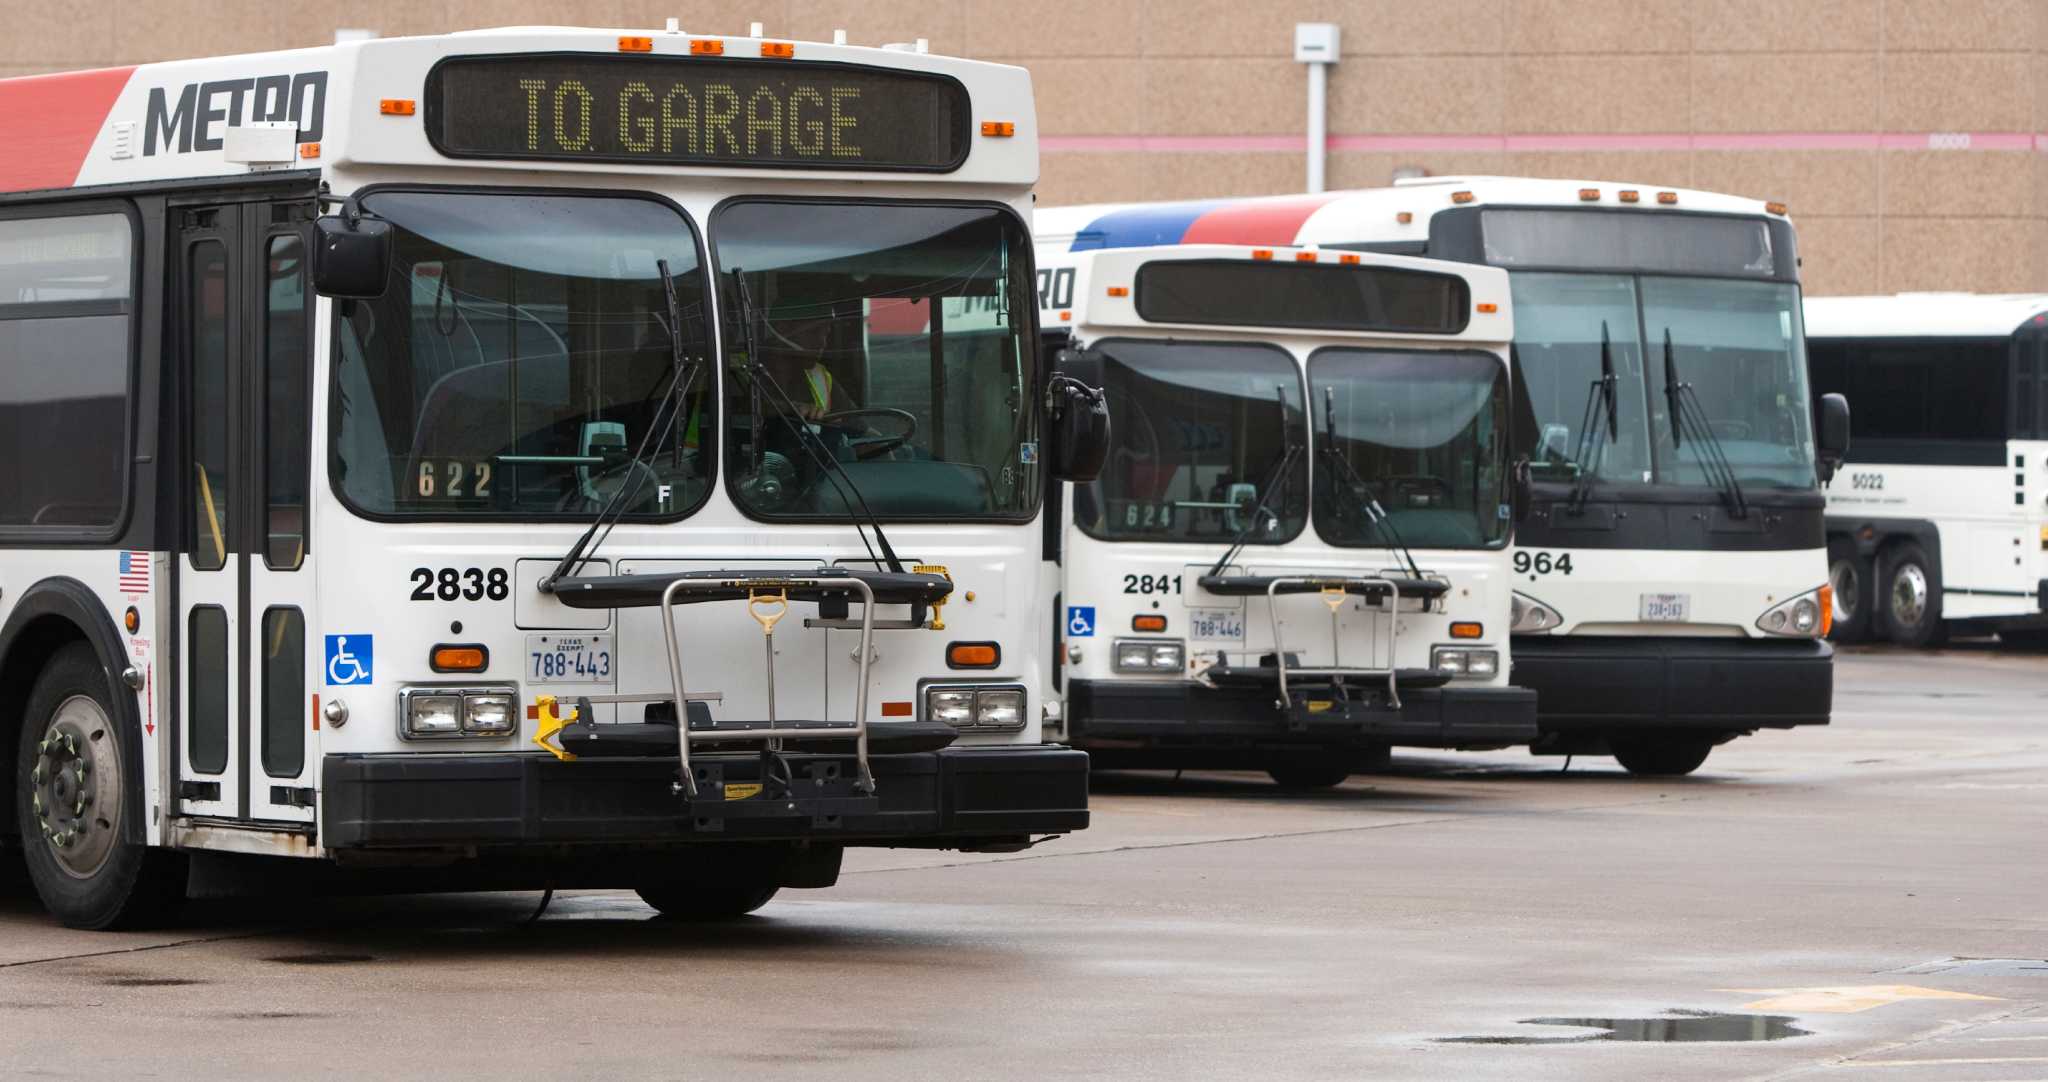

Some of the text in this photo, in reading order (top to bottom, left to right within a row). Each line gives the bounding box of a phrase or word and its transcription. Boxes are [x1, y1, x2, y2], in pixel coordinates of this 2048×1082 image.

[143, 71, 328, 156] METRO
[520, 79, 861, 156] TO GARAGE
[419, 461, 490, 497] 622
[1852, 474, 1884, 490] 5022
[658, 485, 671, 503] F
[410, 567, 509, 601] 2838
[1124, 574, 1182, 595] 2841
[532, 652, 609, 677] 788-443
